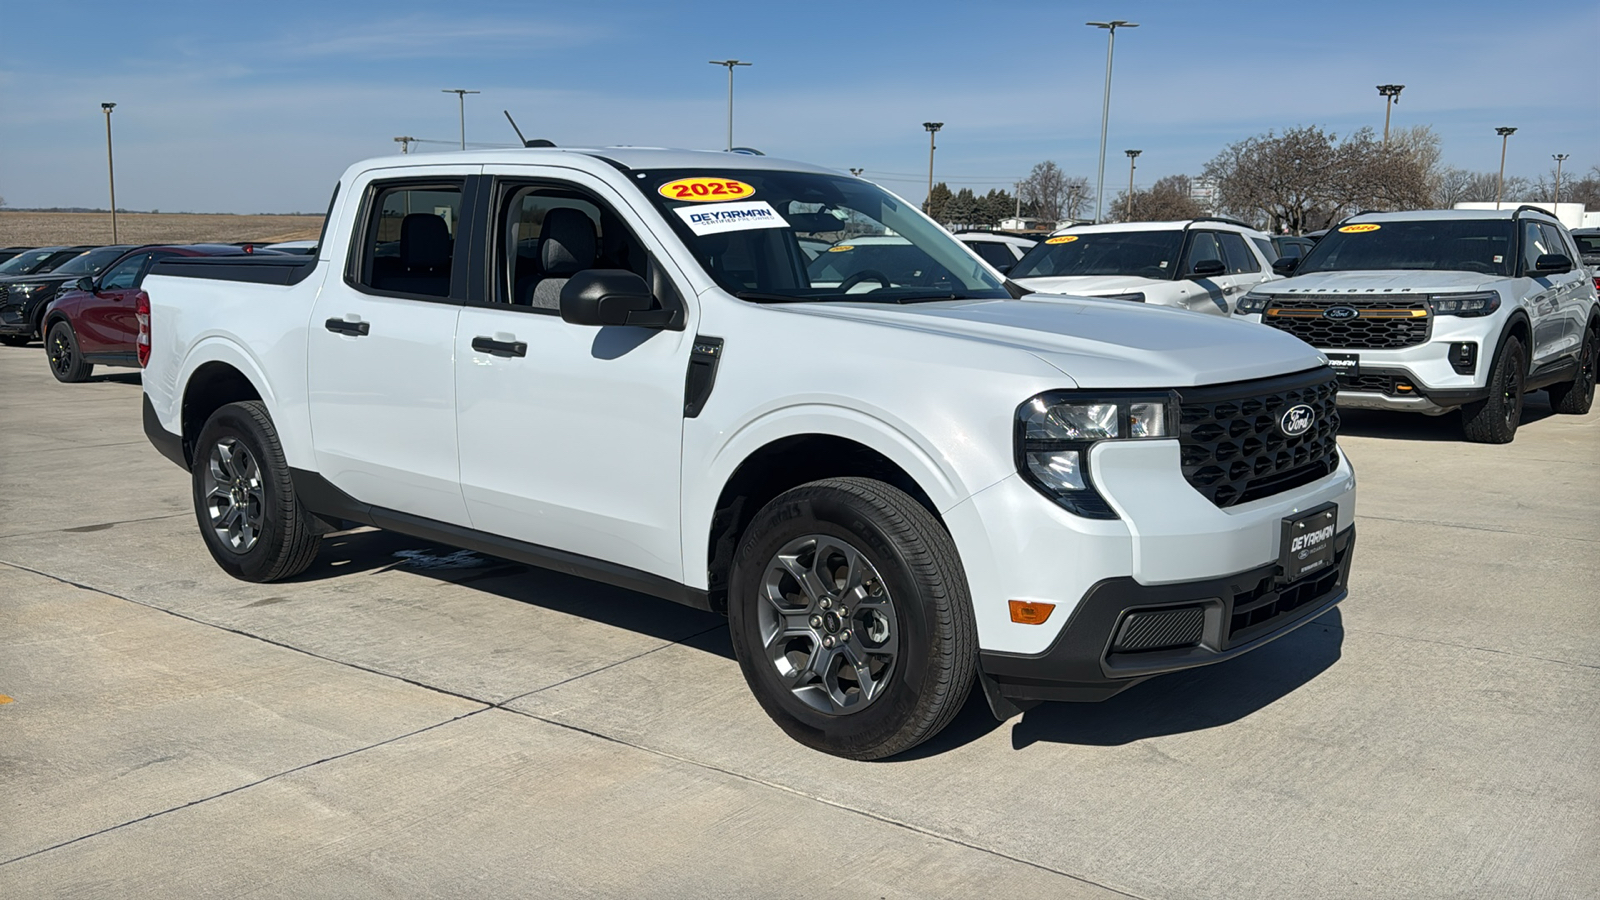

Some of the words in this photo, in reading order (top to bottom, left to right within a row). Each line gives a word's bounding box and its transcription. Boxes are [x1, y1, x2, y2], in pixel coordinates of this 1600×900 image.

[672, 182, 744, 197] 2025
[690, 209, 772, 223] DEYARMAN
[701, 218, 737, 226] CERTIFIED
[1288, 409, 1310, 431] Ford
[1291, 524, 1334, 552] DEYARMAN
